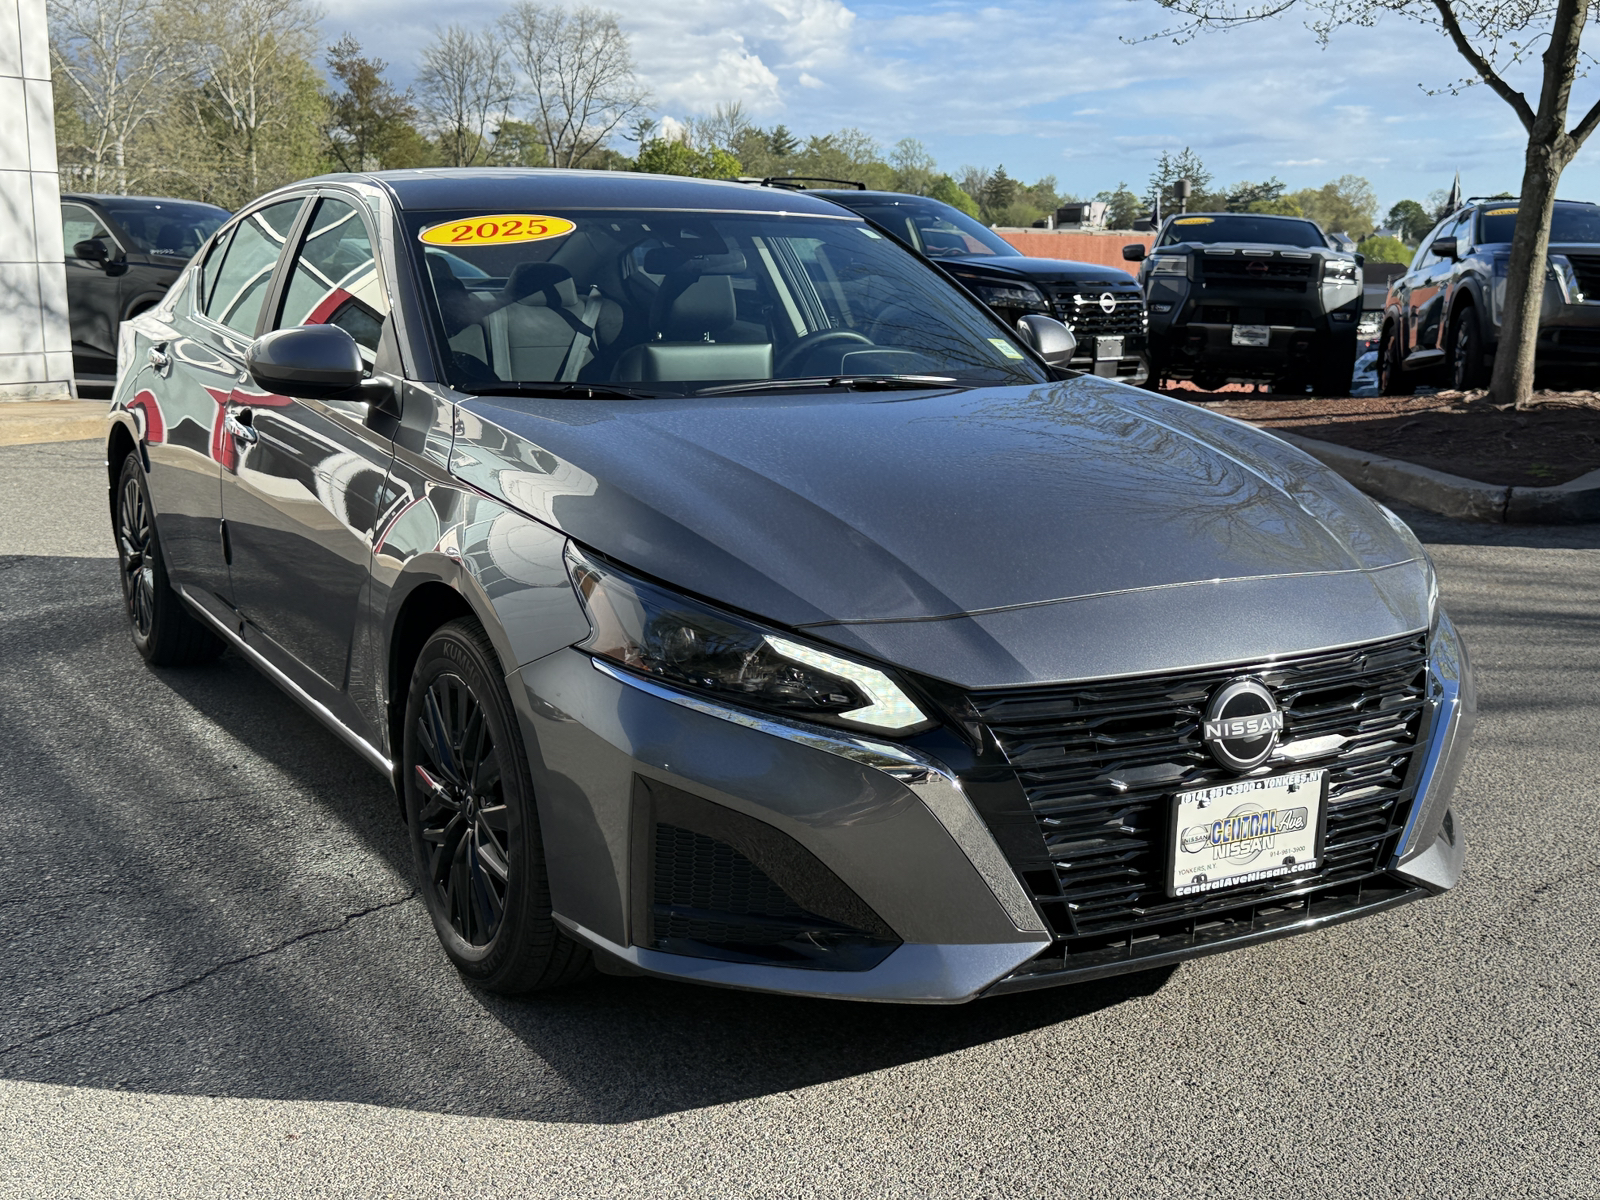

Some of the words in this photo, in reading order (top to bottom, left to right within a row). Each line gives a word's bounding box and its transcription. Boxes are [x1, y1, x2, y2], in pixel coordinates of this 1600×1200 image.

[451, 219, 548, 243] 2025
[443, 641, 481, 689] KUMHO
[1206, 714, 1283, 738] NISSAN
[1183, 834, 1208, 843] NISSAN
[1210, 809, 1278, 847] CENTRAL
[1278, 809, 1305, 832] Ave.
[1212, 835, 1276, 860] NISSAN
